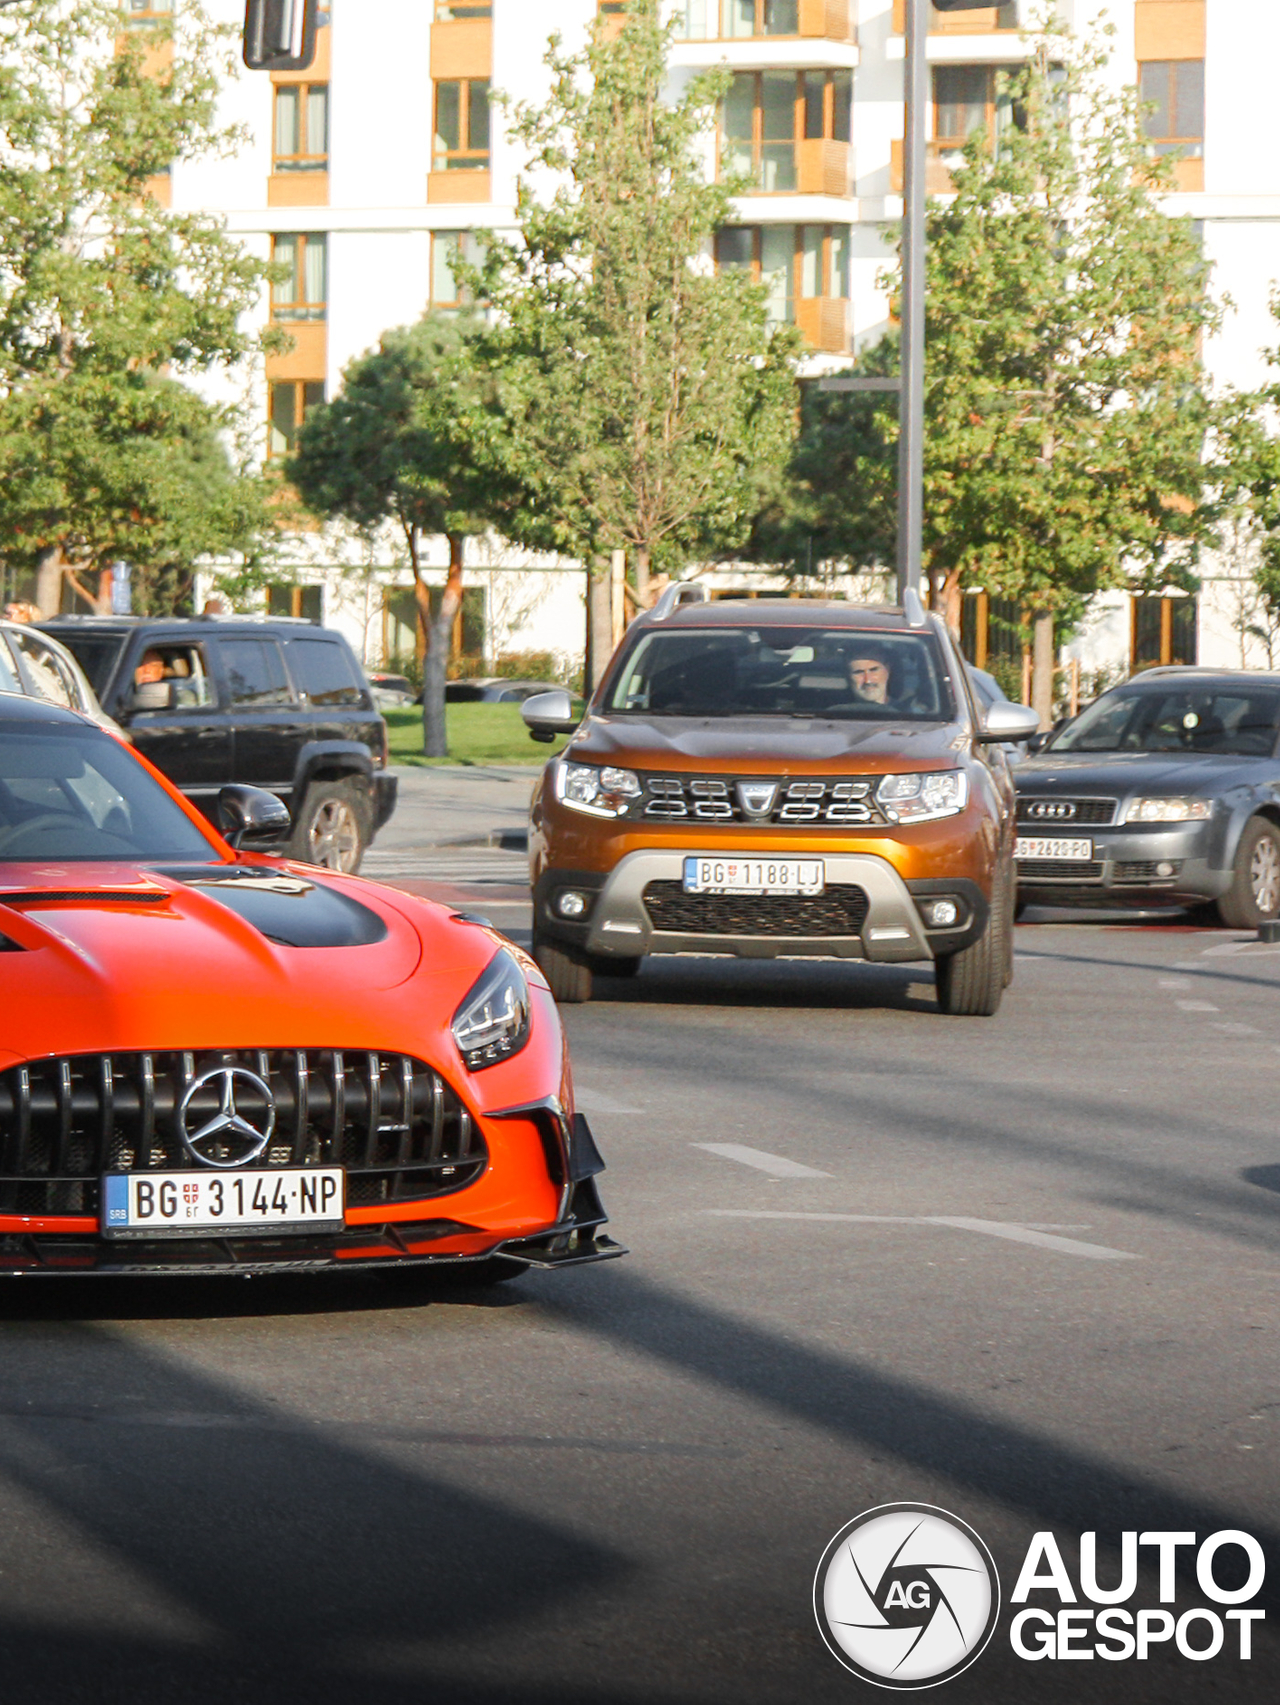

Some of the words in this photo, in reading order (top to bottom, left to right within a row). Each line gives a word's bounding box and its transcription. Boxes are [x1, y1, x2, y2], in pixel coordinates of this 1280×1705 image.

[701, 862, 724, 883] BG
[135, 1180, 178, 1218] BG
[109, 1209, 128, 1220] SRB
